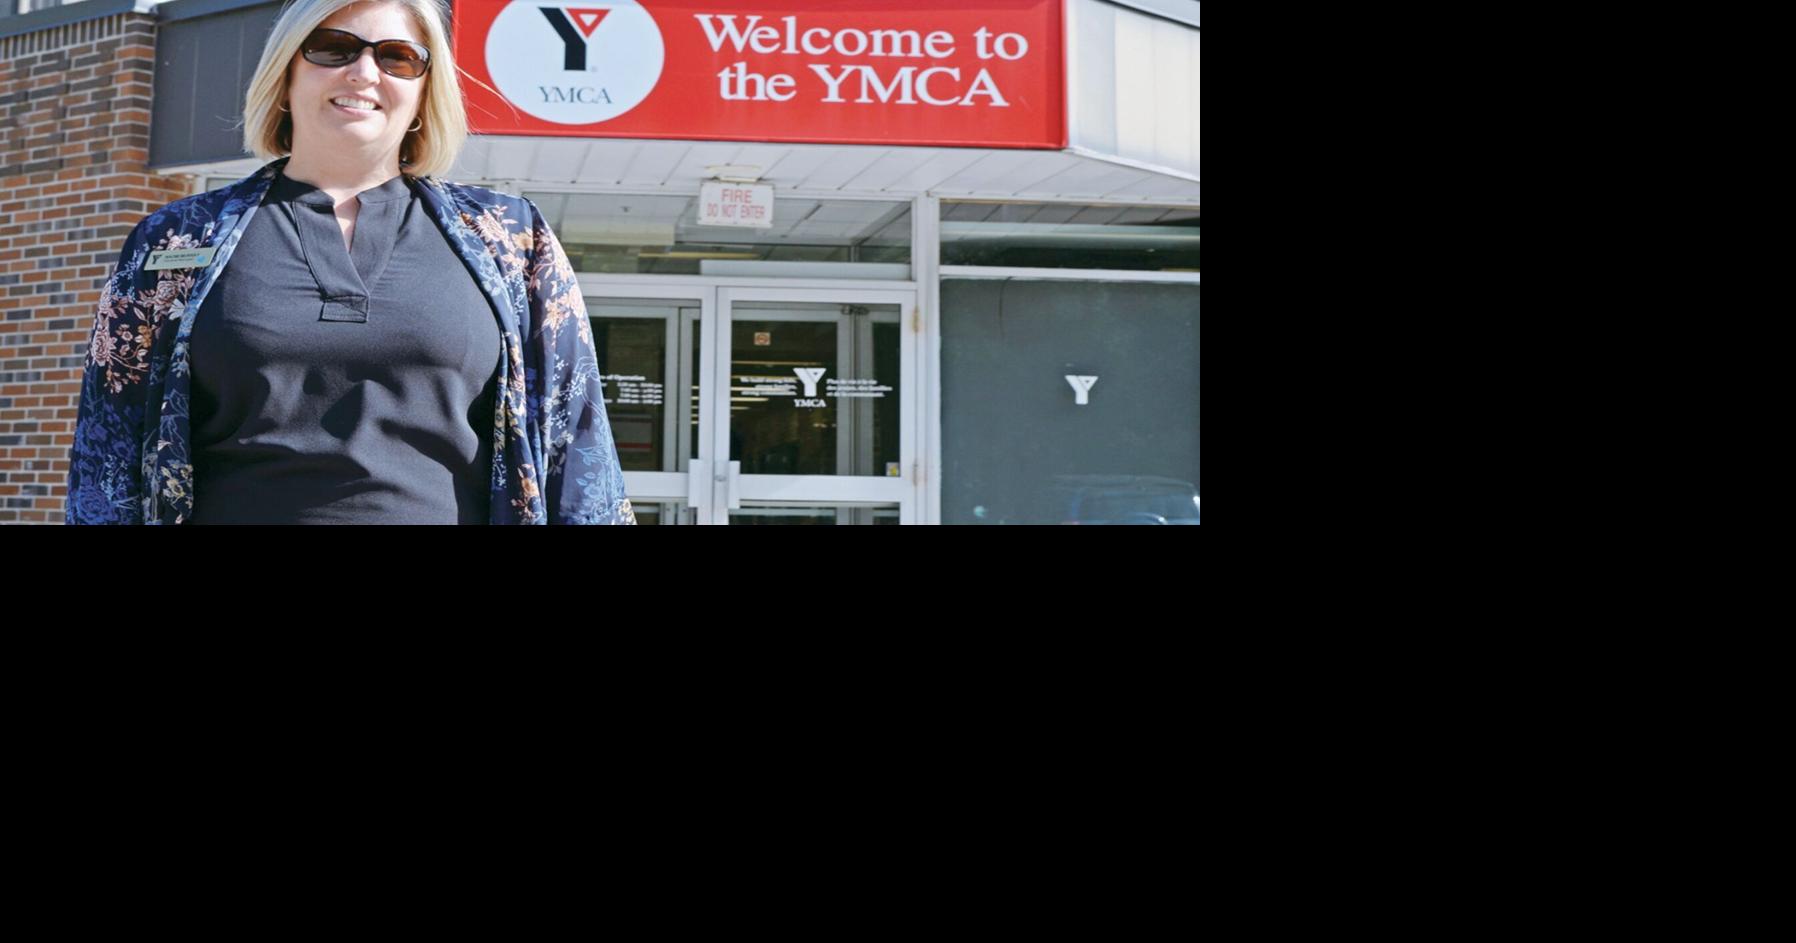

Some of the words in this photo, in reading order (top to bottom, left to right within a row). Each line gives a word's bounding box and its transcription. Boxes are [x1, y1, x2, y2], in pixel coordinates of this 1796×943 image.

[693, 13, 956, 59] Welcome
[973, 26, 1029, 61] to
[717, 61, 797, 102] the
[807, 63, 1011, 107] YMCA
[538, 85, 614, 105] YMCA
[720, 188, 753, 204] FIRE
[706, 202, 719, 218] DO
[721, 204, 737, 218] NOT
[740, 204, 765, 219] ENTER
[793, 398, 827, 408] YMCA
